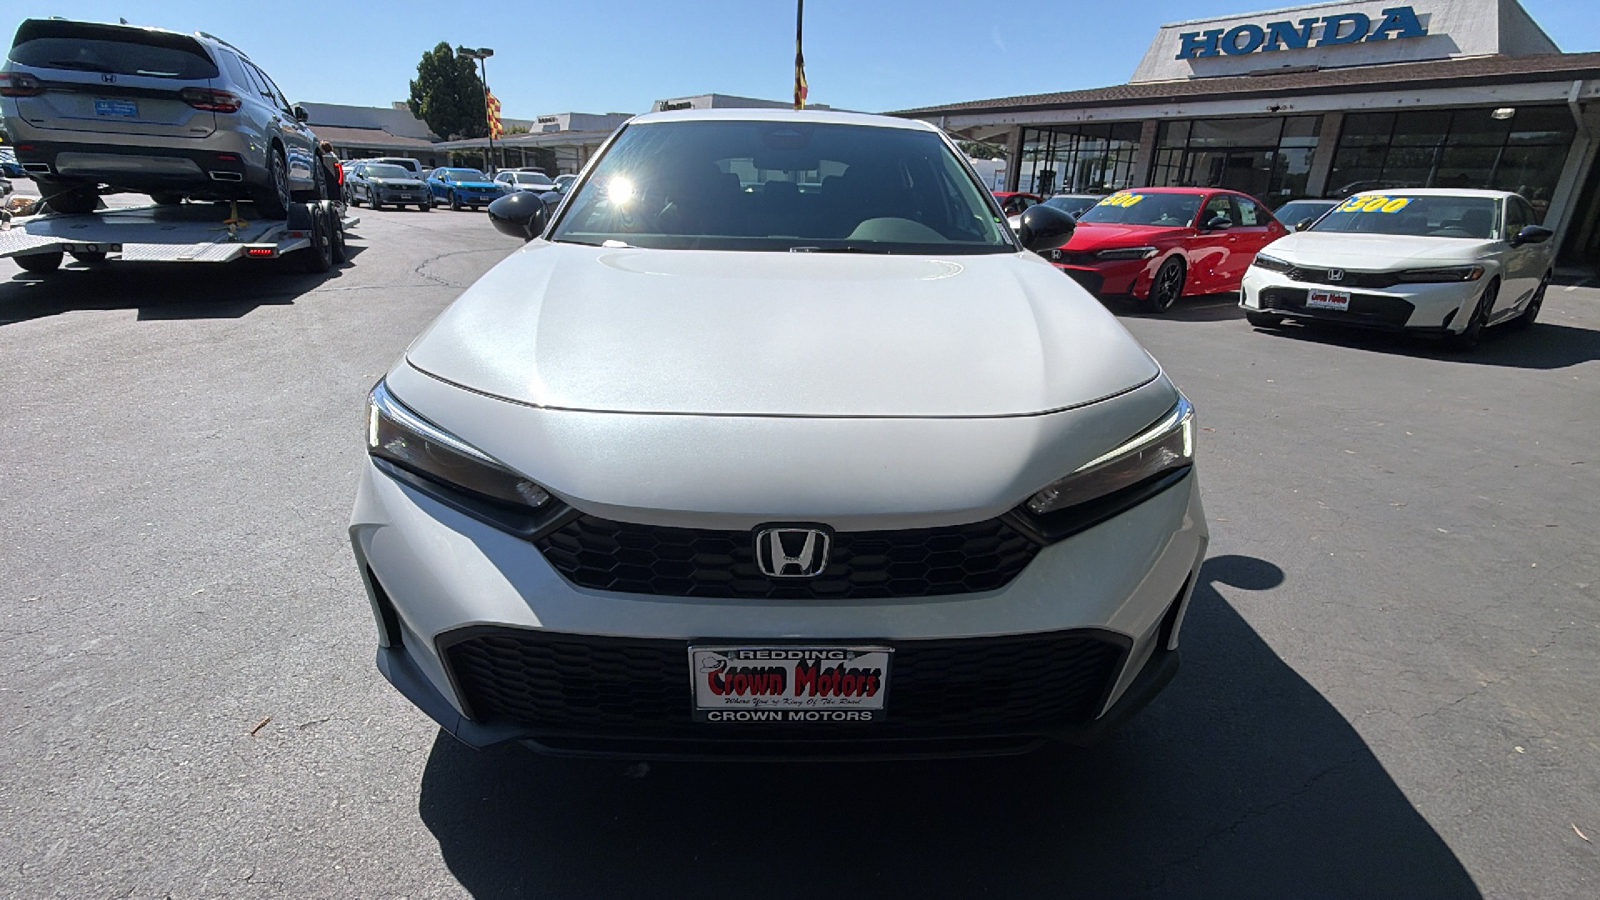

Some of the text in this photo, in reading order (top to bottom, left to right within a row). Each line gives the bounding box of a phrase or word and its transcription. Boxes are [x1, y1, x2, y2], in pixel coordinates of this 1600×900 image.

[1175, 5, 1428, 60] HONDA
[739, 650, 844, 659] REDDING
[707, 663, 879, 697] Crown Motors
[783, 698, 803, 706] King
[806, 698, 819, 706] Of
[707, 711, 873, 721] CROWN MOTORS
